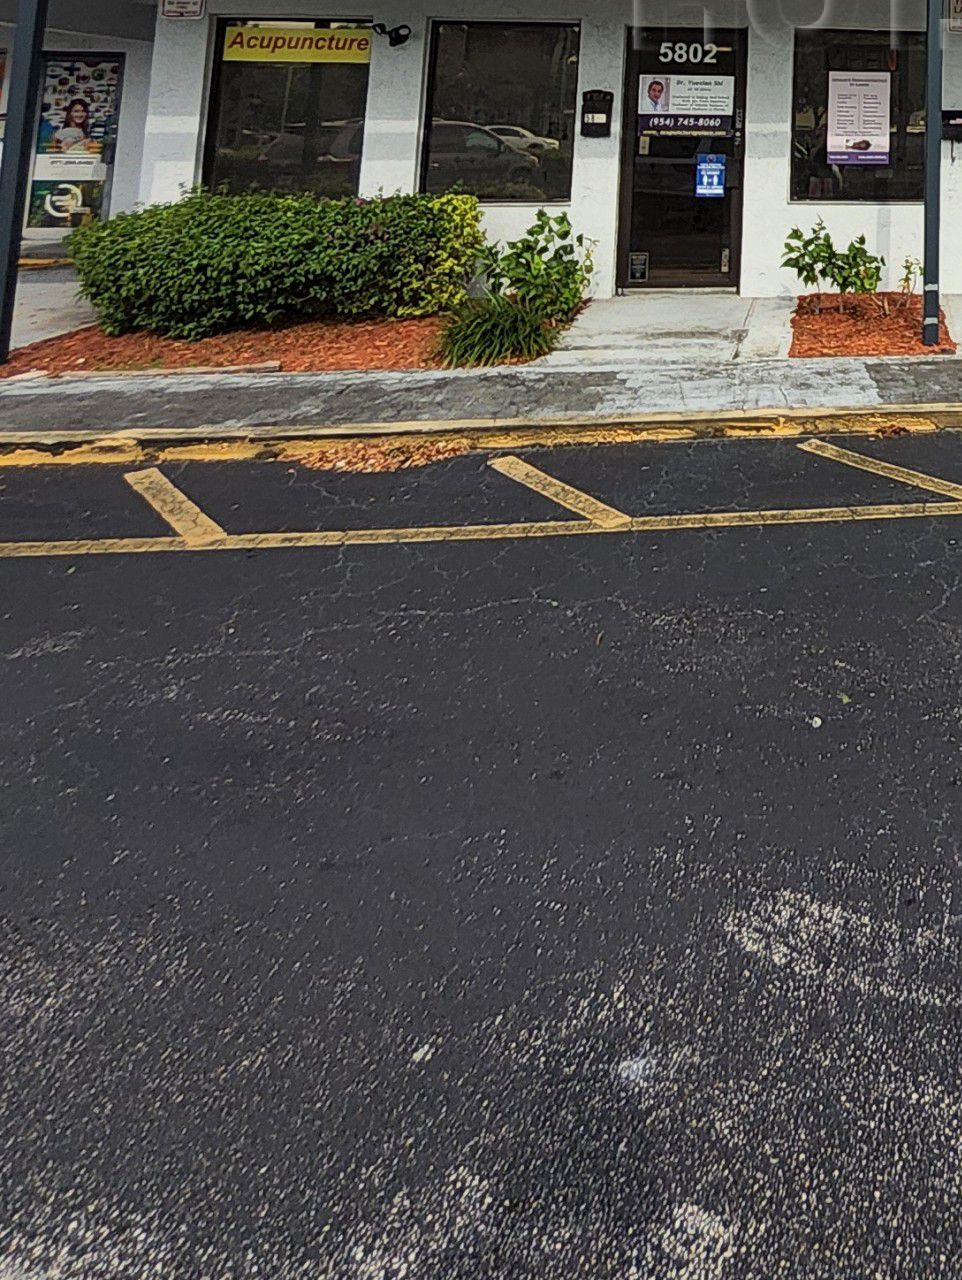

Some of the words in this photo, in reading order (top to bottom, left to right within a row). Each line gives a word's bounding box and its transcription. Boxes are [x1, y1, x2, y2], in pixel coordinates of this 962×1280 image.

[227, 31, 370, 52] Acupuncture
[658, 42, 717, 64] 5802
[649, 117, 675, 128] (954)
